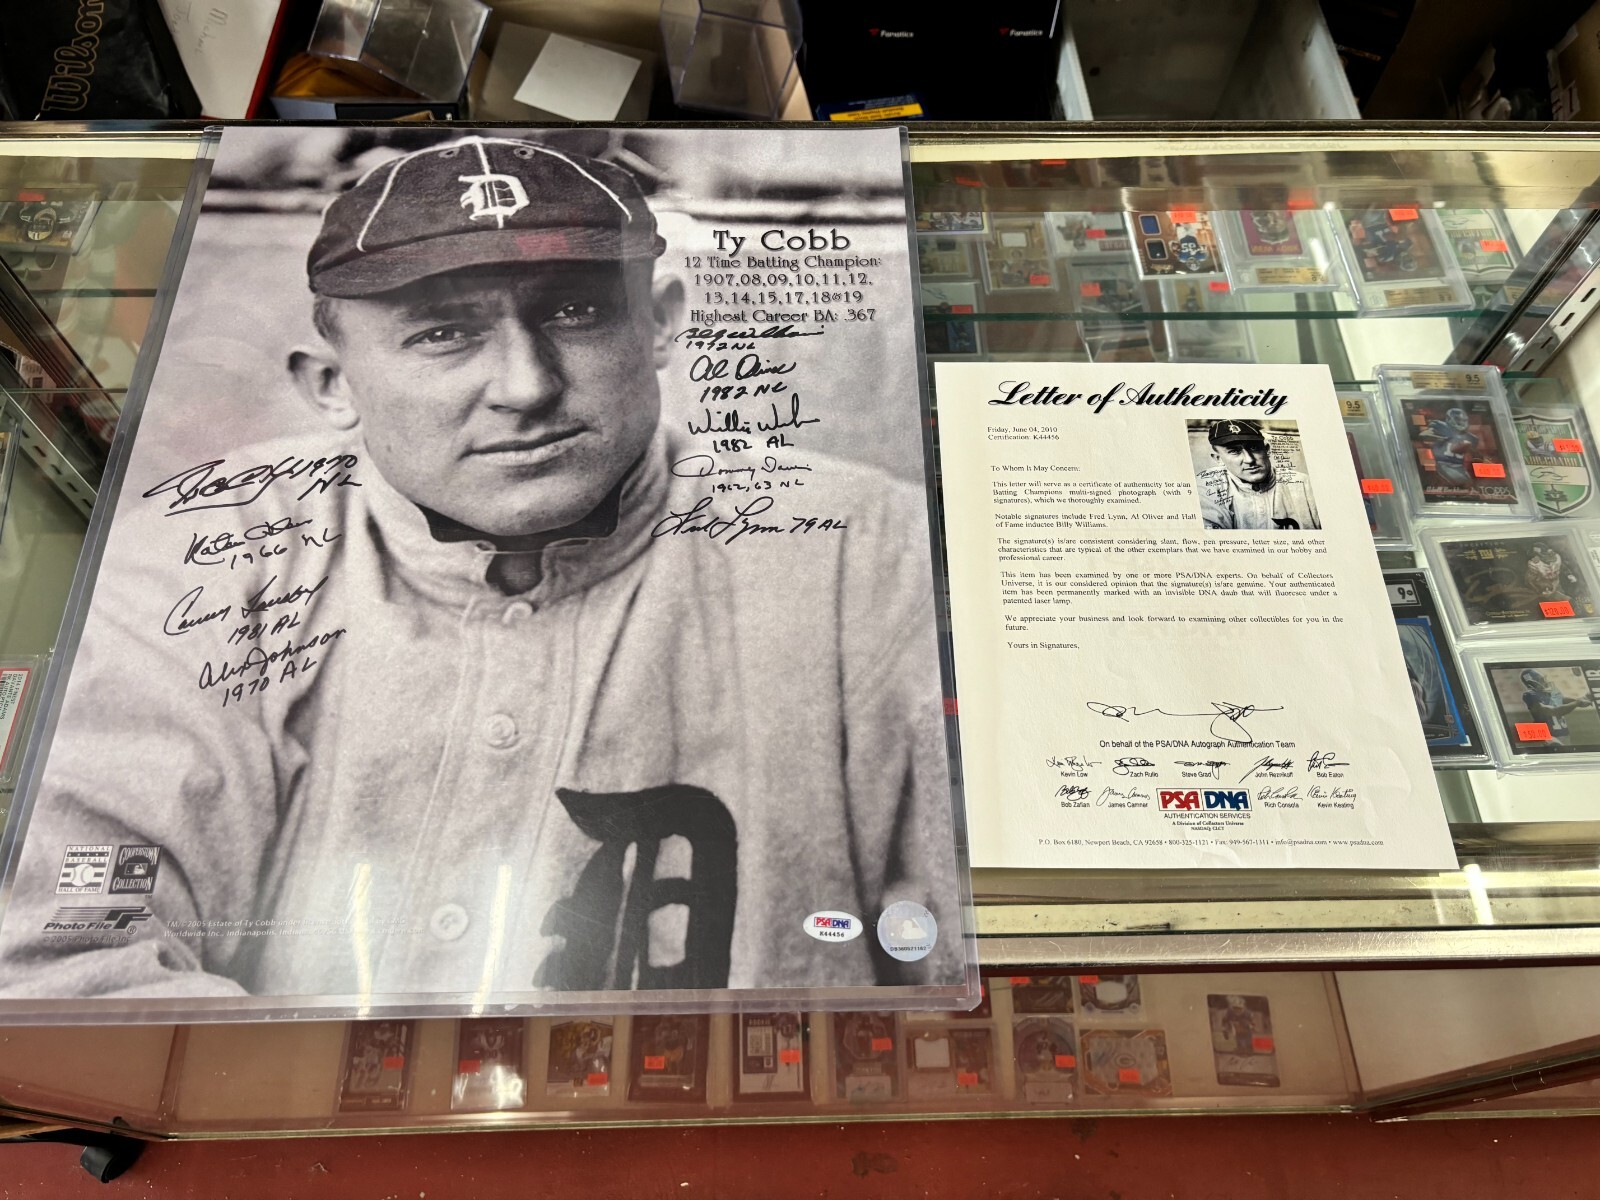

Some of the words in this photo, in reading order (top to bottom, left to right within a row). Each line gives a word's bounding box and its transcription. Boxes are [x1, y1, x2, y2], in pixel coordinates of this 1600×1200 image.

[880, 30, 914, 38] Fanatics
[713, 230, 746, 258] Ty
[760, 228, 850, 251] Cobb
[684, 256, 701, 268] 12
[706, 256, 741, 268] Time
[747, 256, 800, 272] Batting
[804, 256, 882, 270] Champion:
[690, 309, 748, 326] Highest
[752, 310, 808, 322] Career
[814, 310, 839, 322] BA:
[844, 309, 876, 322] .367
[1465, 374, 1480, 382] 9.5
[700, 385, 749, 403] 1982
[988, 380, 1083, 407] Letter
[1086, 382, 1125, 414] of
[1119, 382, 1289, 416] Authenticity
[1346, 400, 1360, 408] 9.5
[987, 426, 1011, 434] Friday,
[1028, 426, 1040, 434] 04,
[712, 439, 753, 454] 1982
[766, 434, 795, 449] AL
[754, 480, 772, 490] 63
[780, 479, 805, 488] NL
[1163, 489, 1181, 497] (with
[1479, 486, 1512, 496] TOPPS
[818, 518, 848, 530] AL
[230, 544, 289, 570] 1966
[228, 623, 268, 646] 1981
[270, 612, 301, 636] AL
[246, 628, 347, 676] Johnson
[1039, 642, 1080, 650] Signatures,
[222, 677, 270, 708] 1970
[280, 657, 318, 684] AL
[1191, 741, 1226, 749] Autograph
[1160, 791, 1200, 811] PSA
[1204, 791, 1249, 811] DNA
[118, 846, 160, 866] COOPERSTOWN
[112, 877, 154, 891] COLLECTION
[43, 922, 86, 930] Photo
[86, 922, 112, 930] File
[244, 920, 254, 928] Ty
[255, 919, 276, 927] Cobb
[816, 917, 831, 928] PSA
[832, 918, 849, 928] DNA
[164, 930, 206, 938] Worldwide
